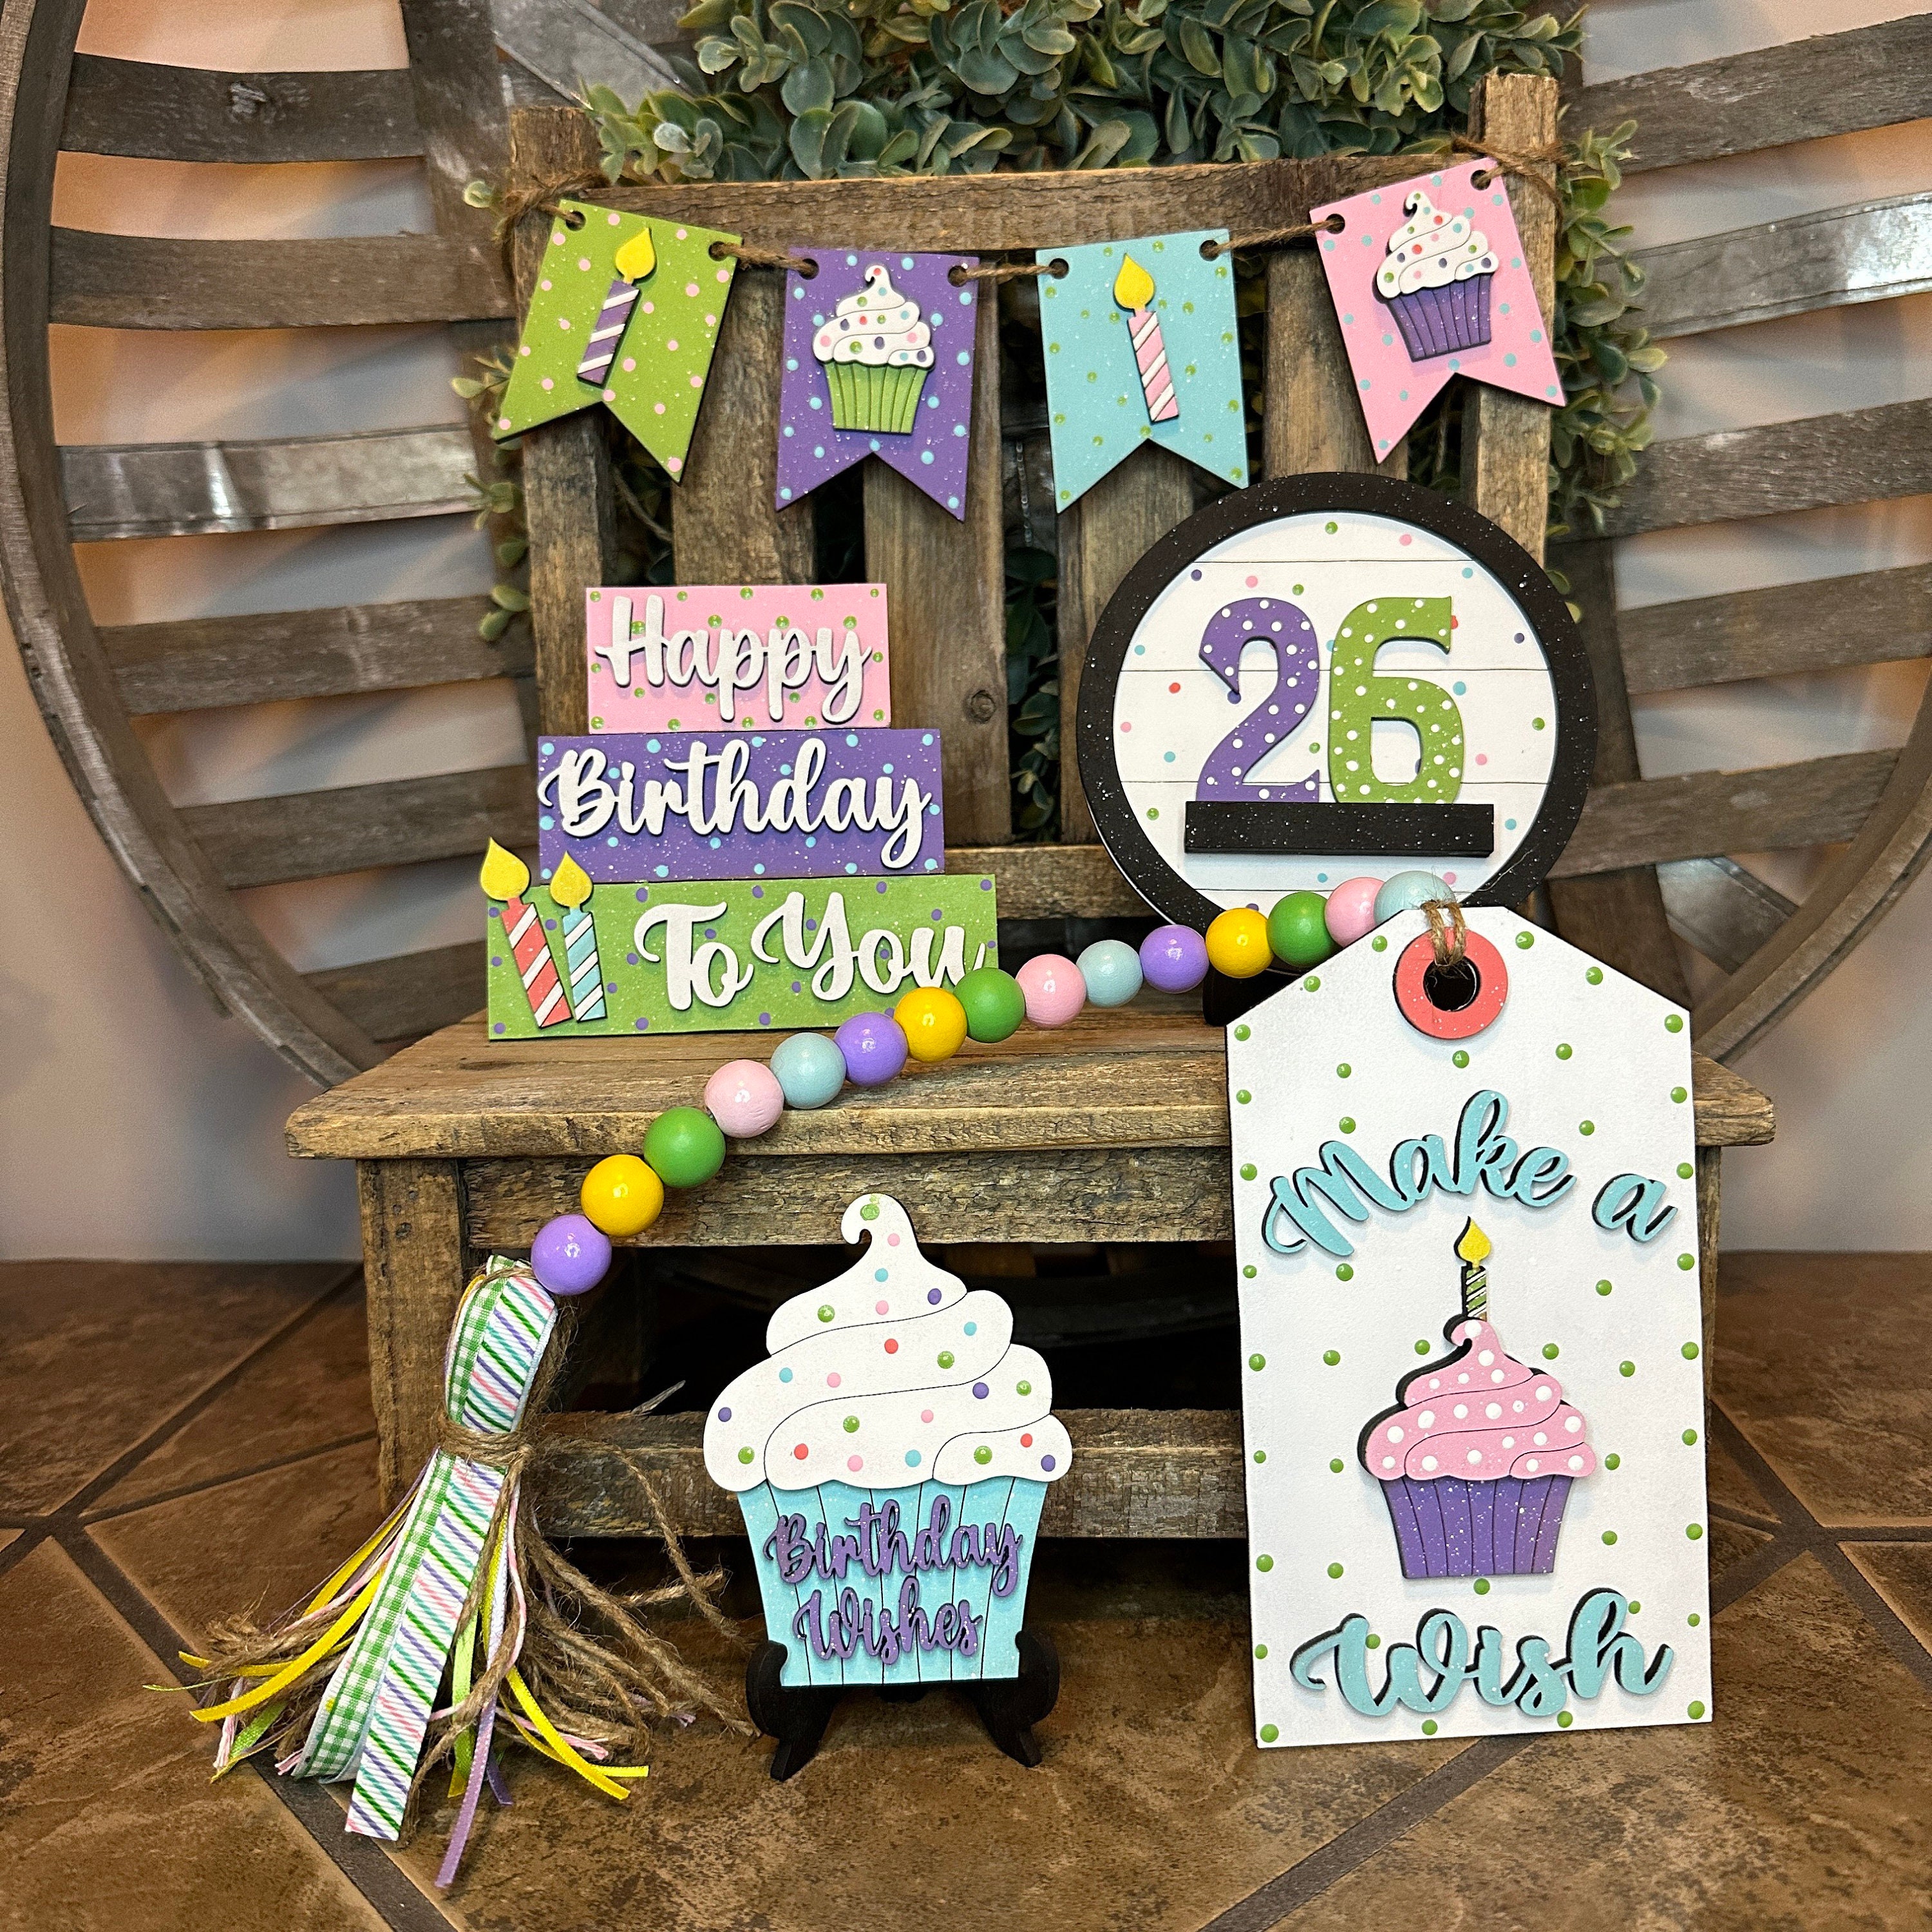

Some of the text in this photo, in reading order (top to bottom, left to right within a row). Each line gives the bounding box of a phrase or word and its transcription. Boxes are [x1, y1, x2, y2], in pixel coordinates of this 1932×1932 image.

[595, 594, 872, 723] Happy
[1196, 596, 1465, 804] 26
[537, 738, 931, 869] Birthday
[634, 891, 986, 1010] To You
[1261, 1090, 1678, 1256] Make a
[763, 1495, 1023, 1597] Birthday
[792, 1575, 983, 1665] Wishes
[1289, 1587, 1674, 1716] Wish
